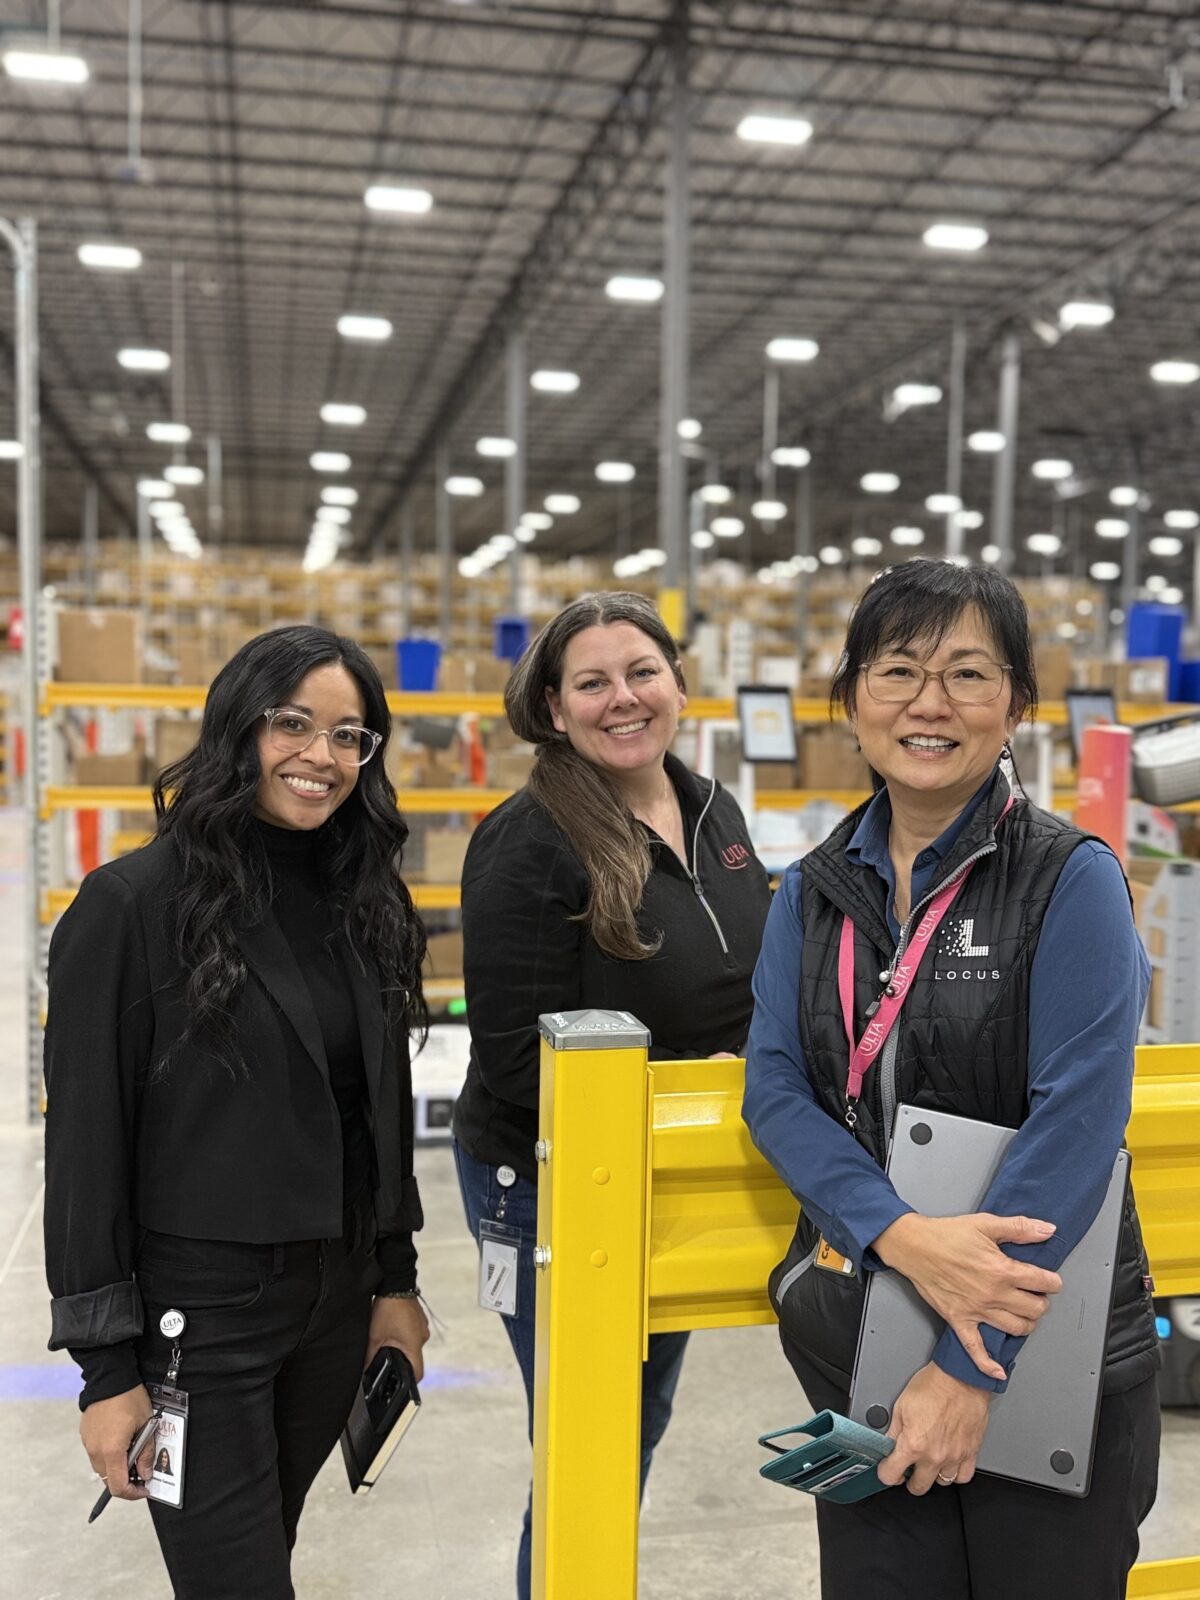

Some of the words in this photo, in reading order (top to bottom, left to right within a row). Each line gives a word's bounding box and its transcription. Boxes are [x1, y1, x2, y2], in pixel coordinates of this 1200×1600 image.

[721, 844, 749, 864] ULTA
[915, 910, 939, 937] ULTA
[934, 970, 1000, 980] LOCUS
[860, 1023, 883, 1052] ULTA
[163, 1317, 182, 1328] ULTA
